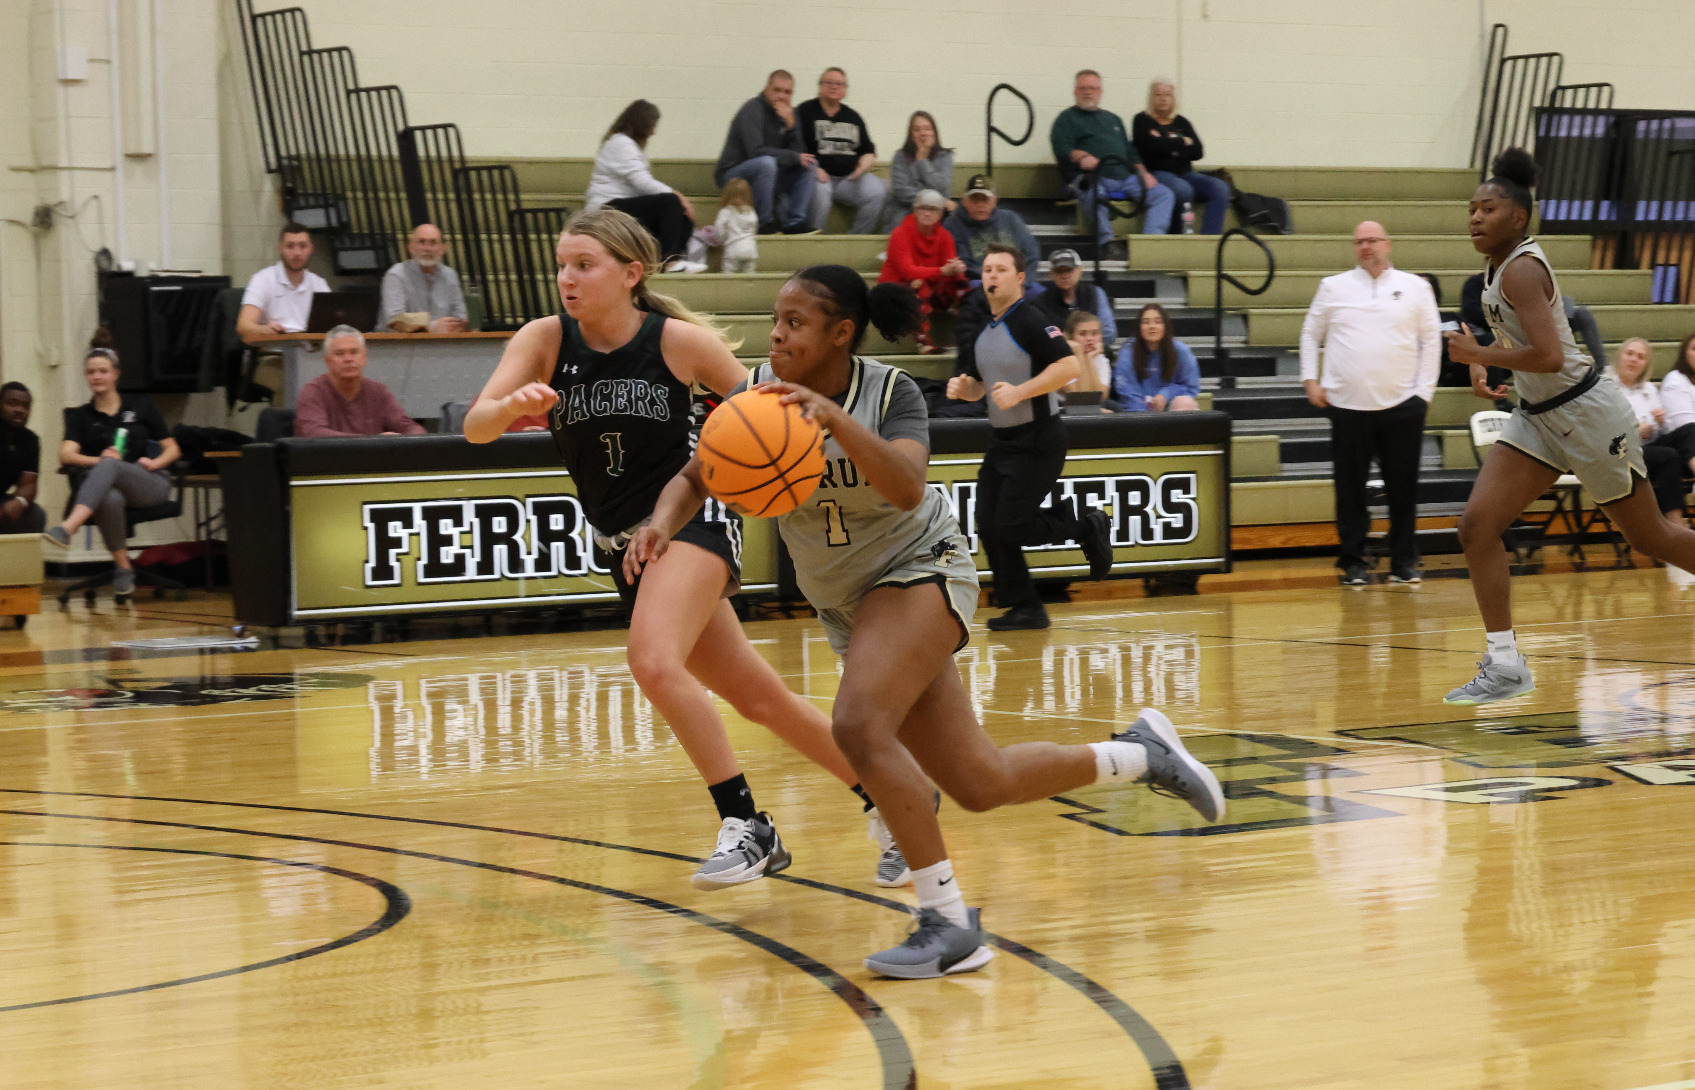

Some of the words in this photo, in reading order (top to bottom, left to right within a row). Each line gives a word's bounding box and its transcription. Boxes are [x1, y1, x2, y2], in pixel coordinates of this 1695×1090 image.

[553, 378, 671, 430] PACERS
[599, 432, 626, 477] 1
[362, 494, 612, 588] FERR
[816, 499, 851, 547] 1
